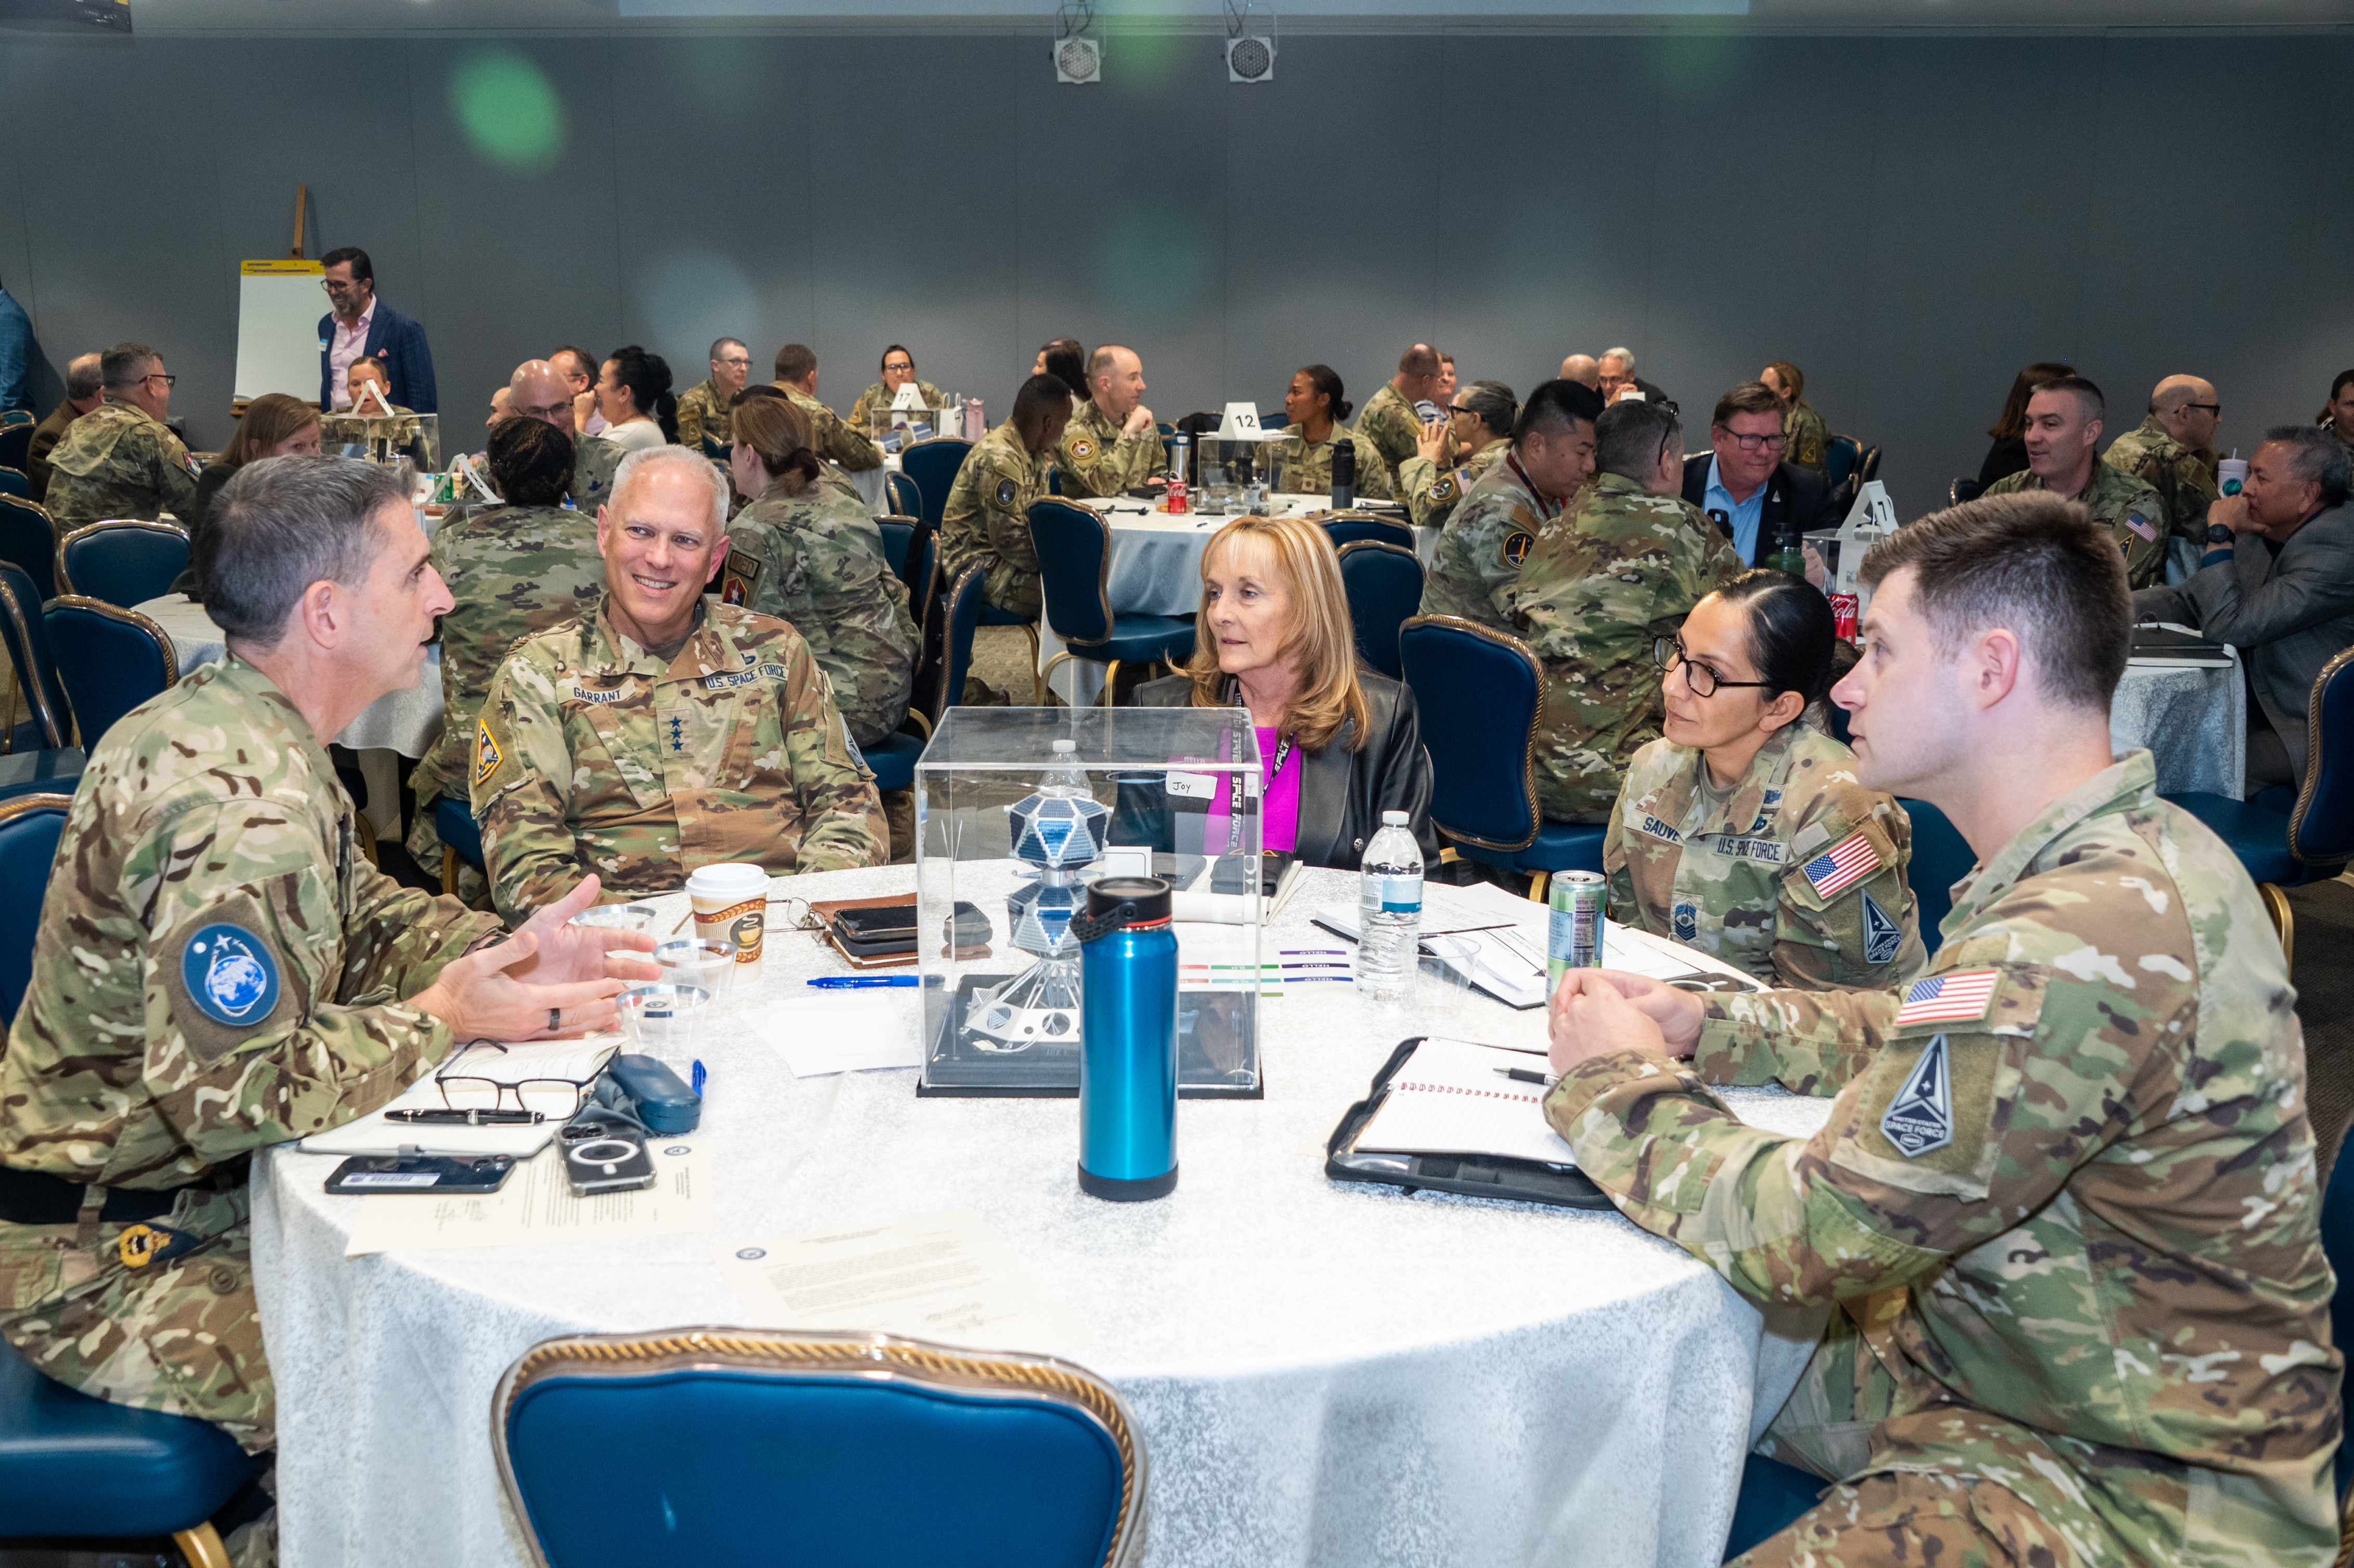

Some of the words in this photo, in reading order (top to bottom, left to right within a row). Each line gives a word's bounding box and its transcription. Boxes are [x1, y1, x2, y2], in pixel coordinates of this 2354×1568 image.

[899, 393, 911, 402] 17
[1235, 415, 1256, 427] 12
[733, 555, 754, 575] MED
[709, 677, 726, 688] U.S.
[727, 670, 758, 686] SPACE
[758, 664, 786, 678] FORCE
[574, 687, 621, 703] GARRANT
[1232, 777, 1241, 808] SPACE
[1717, 838, 1733, 855] U.S.
[1751, 841, 1781, 861] FORCE
[1869, 947, 1885, 960] SPACE
[1885, 935, 1901, 949] FORCE
[1885, 1120, 1913, 1133] SPACE
[1914, 1126, 1945, 1139] FORCE
